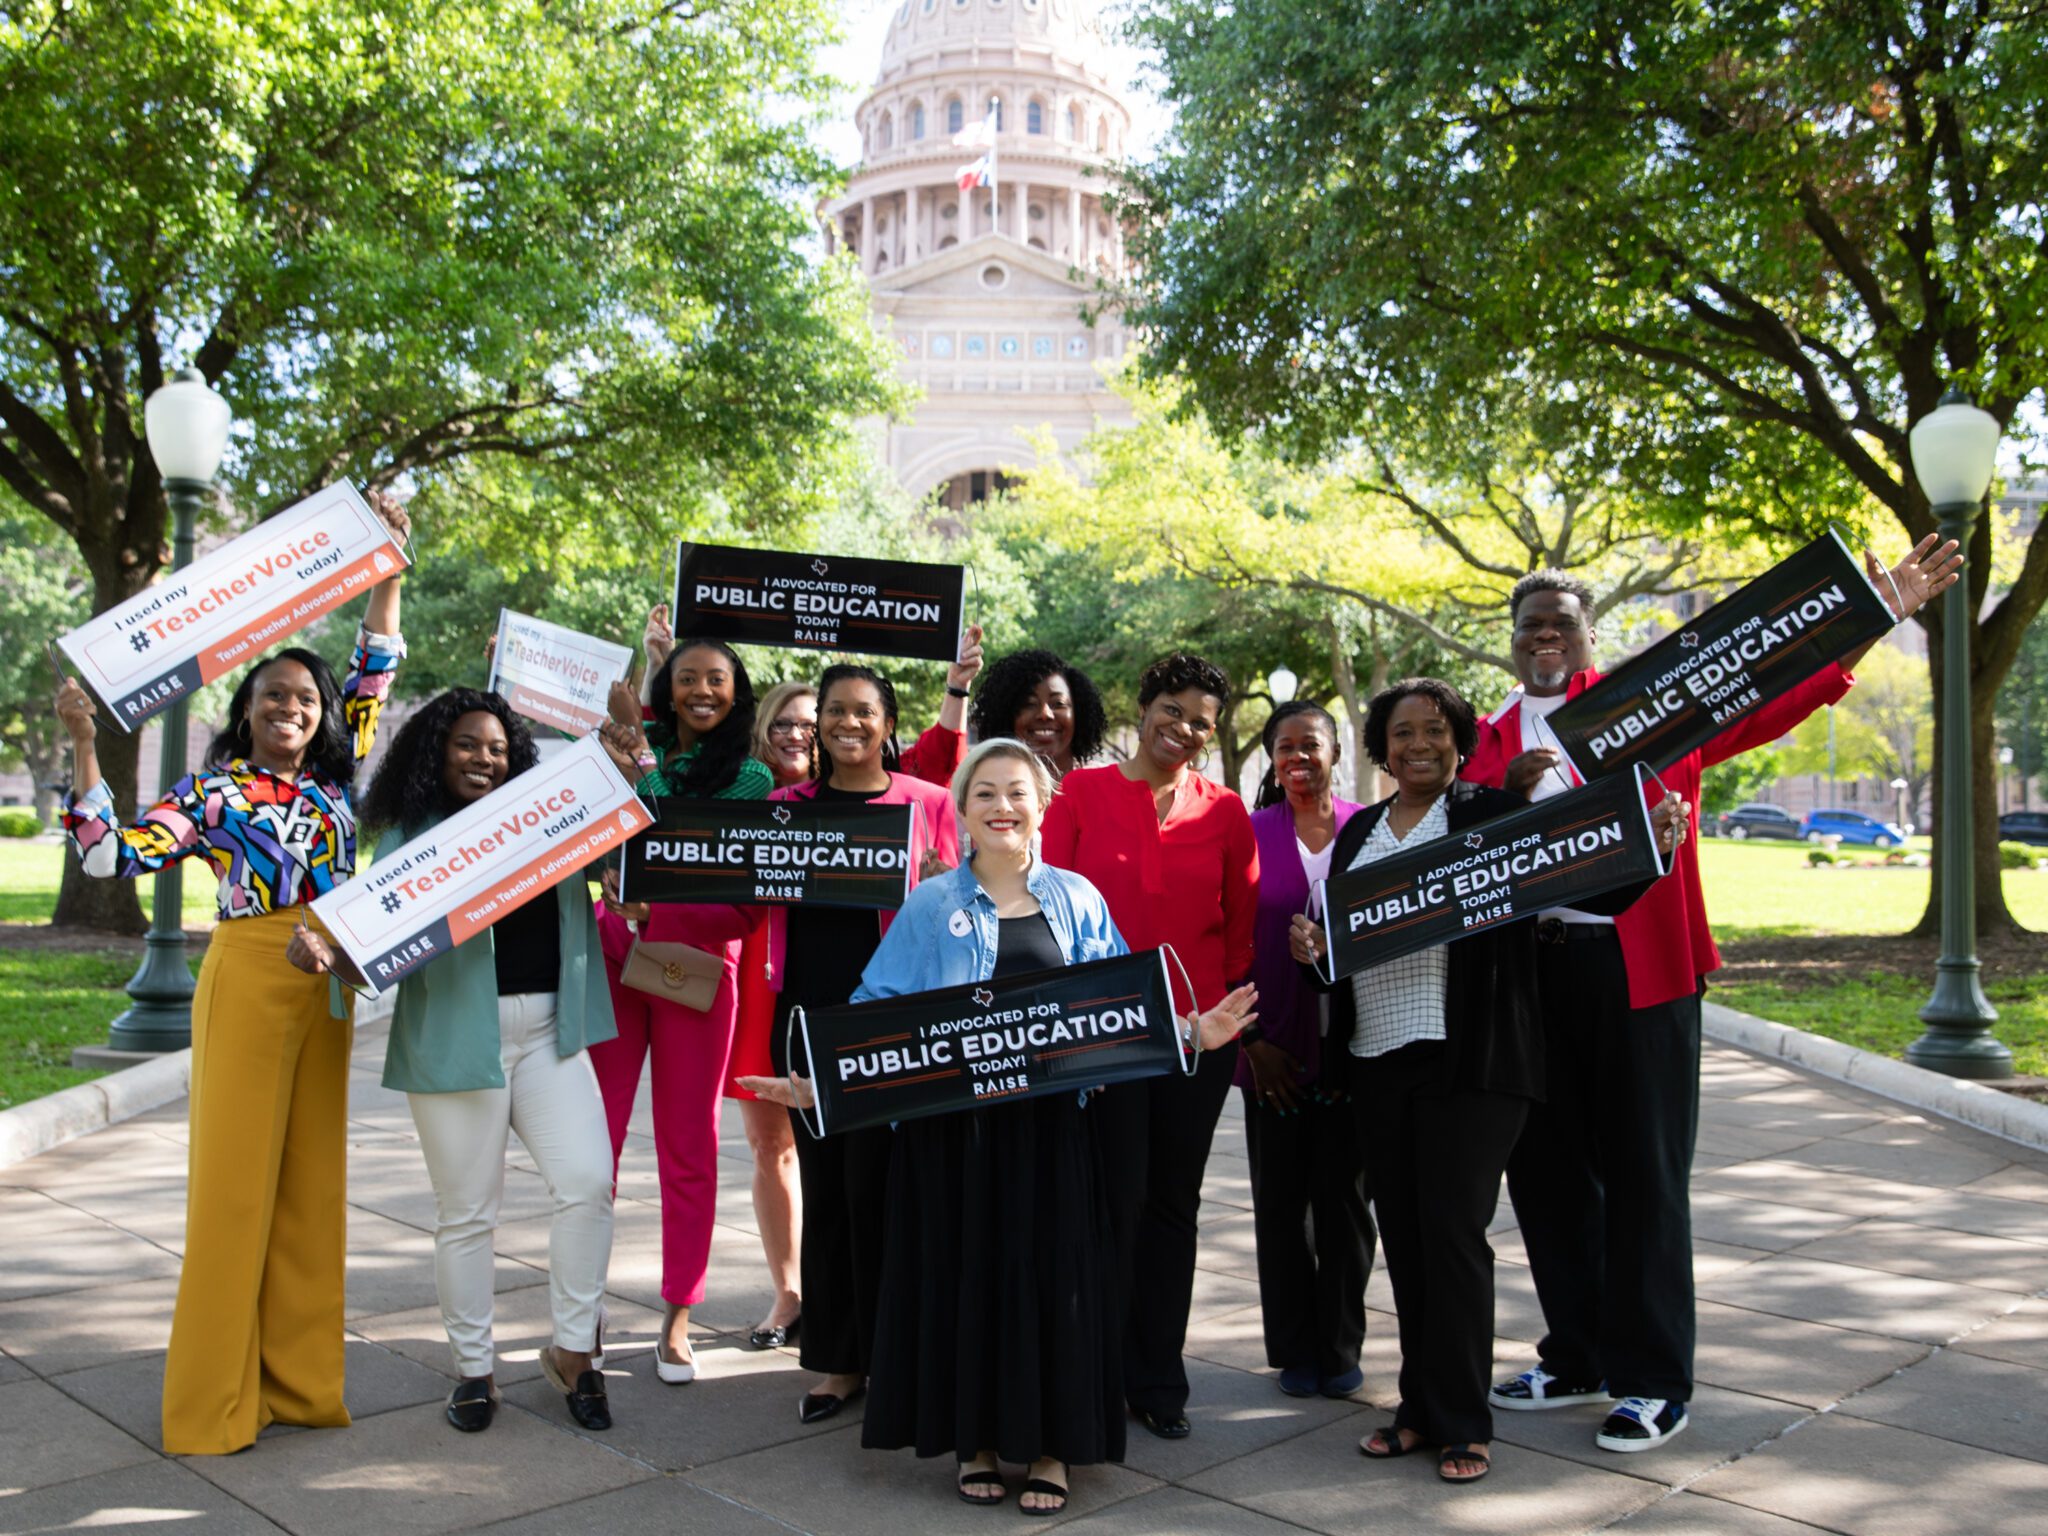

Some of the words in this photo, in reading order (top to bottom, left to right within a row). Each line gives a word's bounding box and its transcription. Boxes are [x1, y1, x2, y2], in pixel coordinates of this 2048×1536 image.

[296, 547, 345, 580] today!
[129, 531, 331, 653] #TeacherVoice
[696, 584, 785, 609] PUBLIC
[793, 593, 940, 623] EDUCATION
[764, 577, 768, 587] I
[772, 578, 847, 593] ADVOCATED
[851, 584, 876, 596] FOR
[114, 621, 123, 631] I
[125, 599, 163, 626] used
[165, 585, 189, 603] my
[216, 640, 249, 663] Texas
[247, 614, 292, 645] Teacher
[292, 585, 344, 619] Advocacy
[343, 568, 371, 590] Days
[795, 614, 840, 628] TODAY!
[794, 629, 838, 643] RAISE
[506, 639, 599, 685] #TeacherVoice
[1588, 689, 1684, 761] PUBLIC
[1685, 584, 1847, 698] EDUCATION
[1644, 684, 1652, 696] I
[1654, 634, 1732, 692] ADVOCATED
[1732, 616, 1763, 641] FOR
[124, 674, 184, 716] RAISE
[569, 685, 595, 703] today!
[1701, 671, 1751, 708] TODAY!
[1711, 687, 1760, 725] RAISE
[544, 804, 590, 838] today!
[721, 828, 725, 839] I
[729, 828, 813, 842] ADVOCATED
[816, 832, 845, 843] FOR
[365, 882, 374, 893] I
[377, 859, 413, 887] used
[415, 844, 439, 864] my
[380, 788, 577, 915] #TeacherVoice
[645, 841, 744, 864] PUBLIC
[1418, 874, 1423, 885] I
[1426, 845, 1508, 883] ADVOCATED
[1512, 833, 1541, 850] FOR
[465, 901, 498, 923] Texas
[496, 874, 540, 903] Teacher
[540, 841, 590, 878] Advocacy
[589, 825, 616, 846] Days
[755, 884, 803, 898] RAISE
[756, 868, 806, 881] TODAY!
[1349, 884, 1446, 932] PUBLIC
[1453, 821, 1623, 896] EDUCATION
[1460, 885, 1511, 910] TODAY!
[1463, 902, 1513, 928] RAISE
[376, 935, 434, 977] RAISE
[920, 1026, 925, 1038] I
[929, 1009, 1024, 1036] ADVOCATED
[1028, 1002, 1060, 1019] FOR
[838, 1040, 953, 1081] PUBLIC
[961, 1005, 1148, 1060] EDUCATION
[969, 1054, 1026, 1075] TODAY!
[973, 1074, 1028, 1096] RAISE
